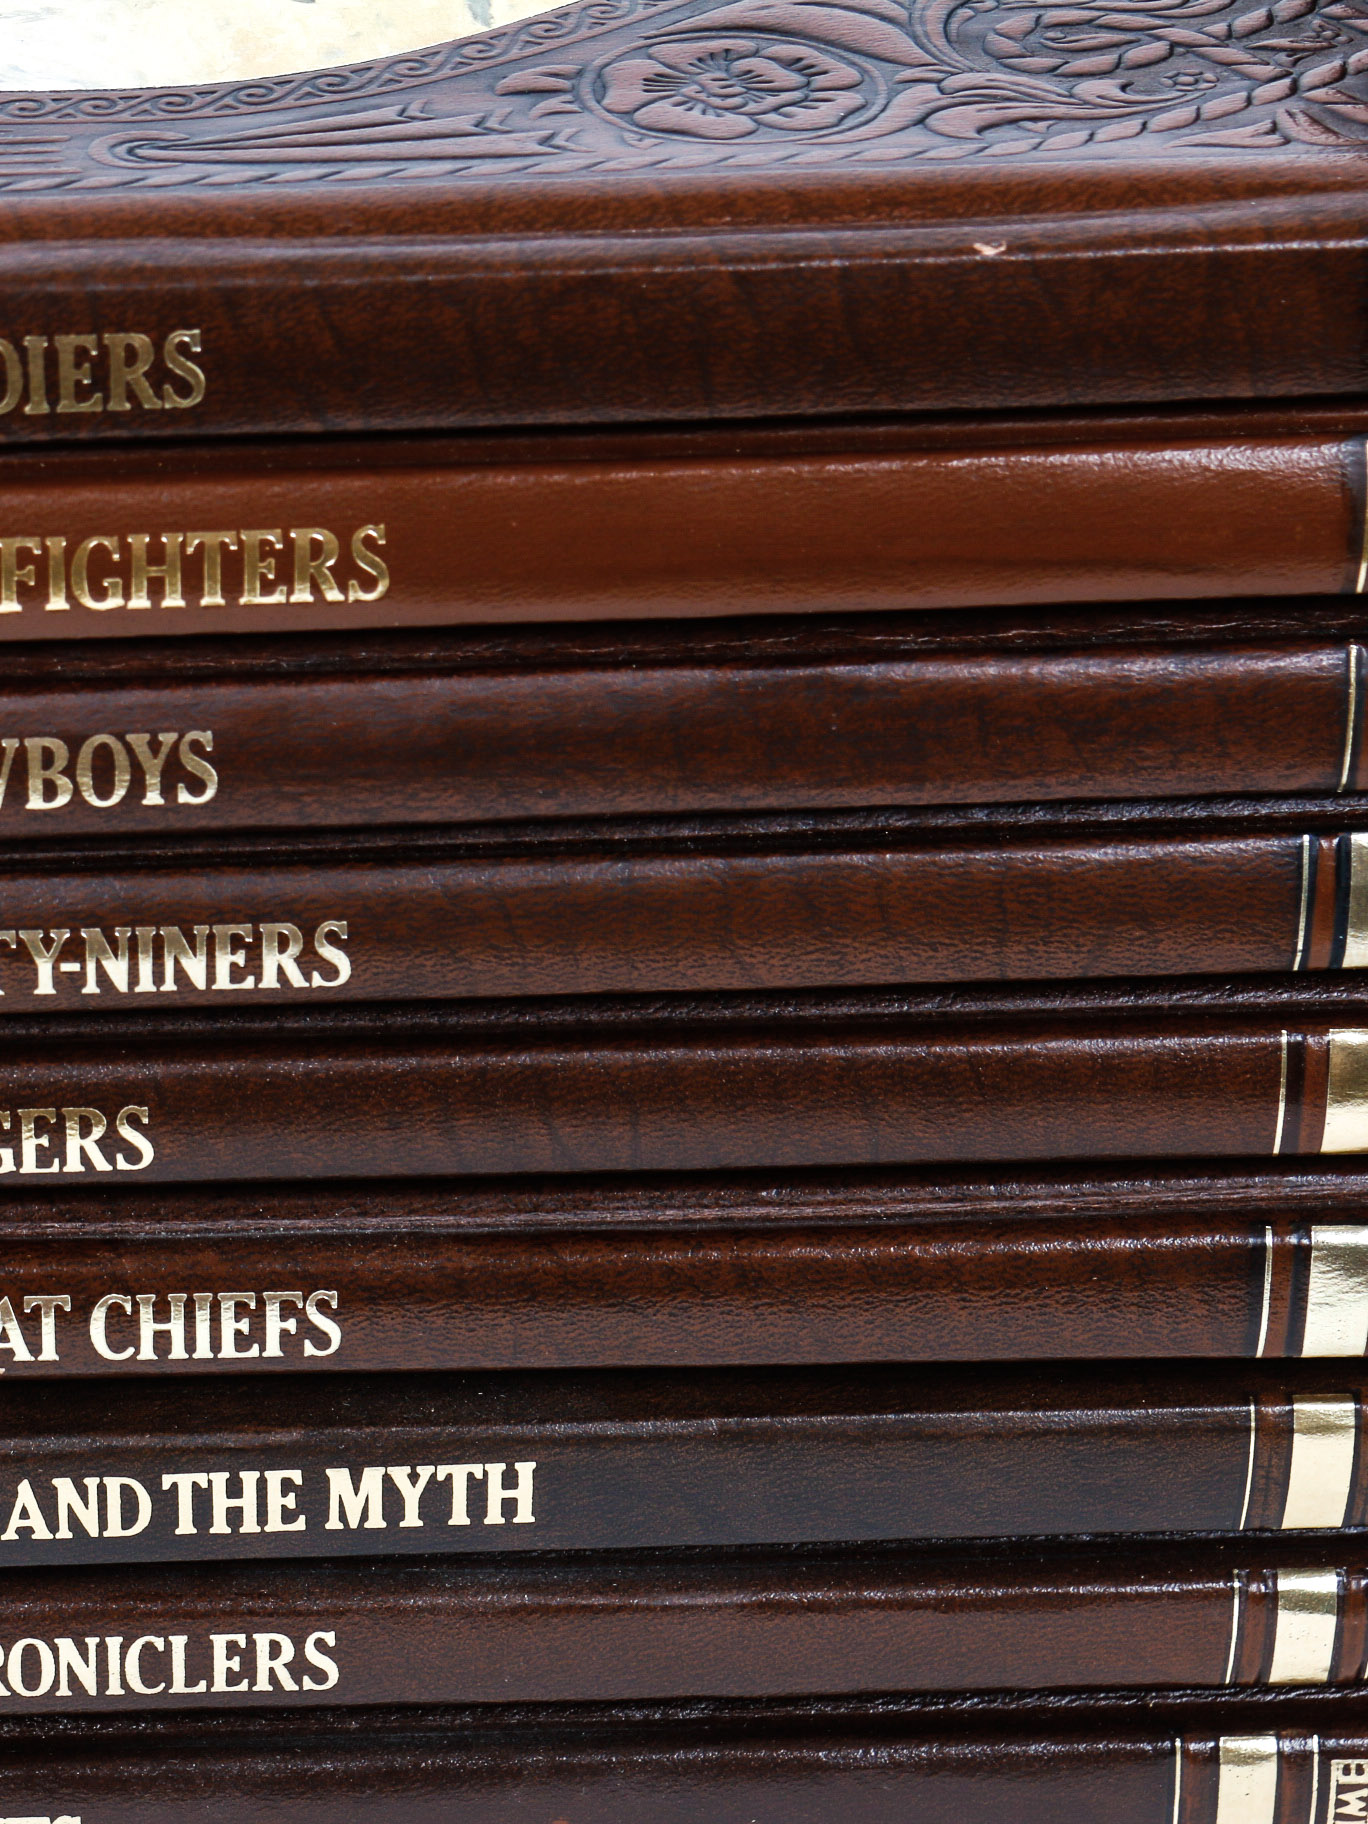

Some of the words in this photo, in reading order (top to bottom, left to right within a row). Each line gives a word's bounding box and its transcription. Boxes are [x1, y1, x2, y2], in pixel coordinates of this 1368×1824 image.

[89, 1290, 343, 1362] CHIEFS
[0, 1475, 153, 1541] AND
[160, 1469, 308, 1536] THE
[324, 1461, 537, 1531] MYTH
